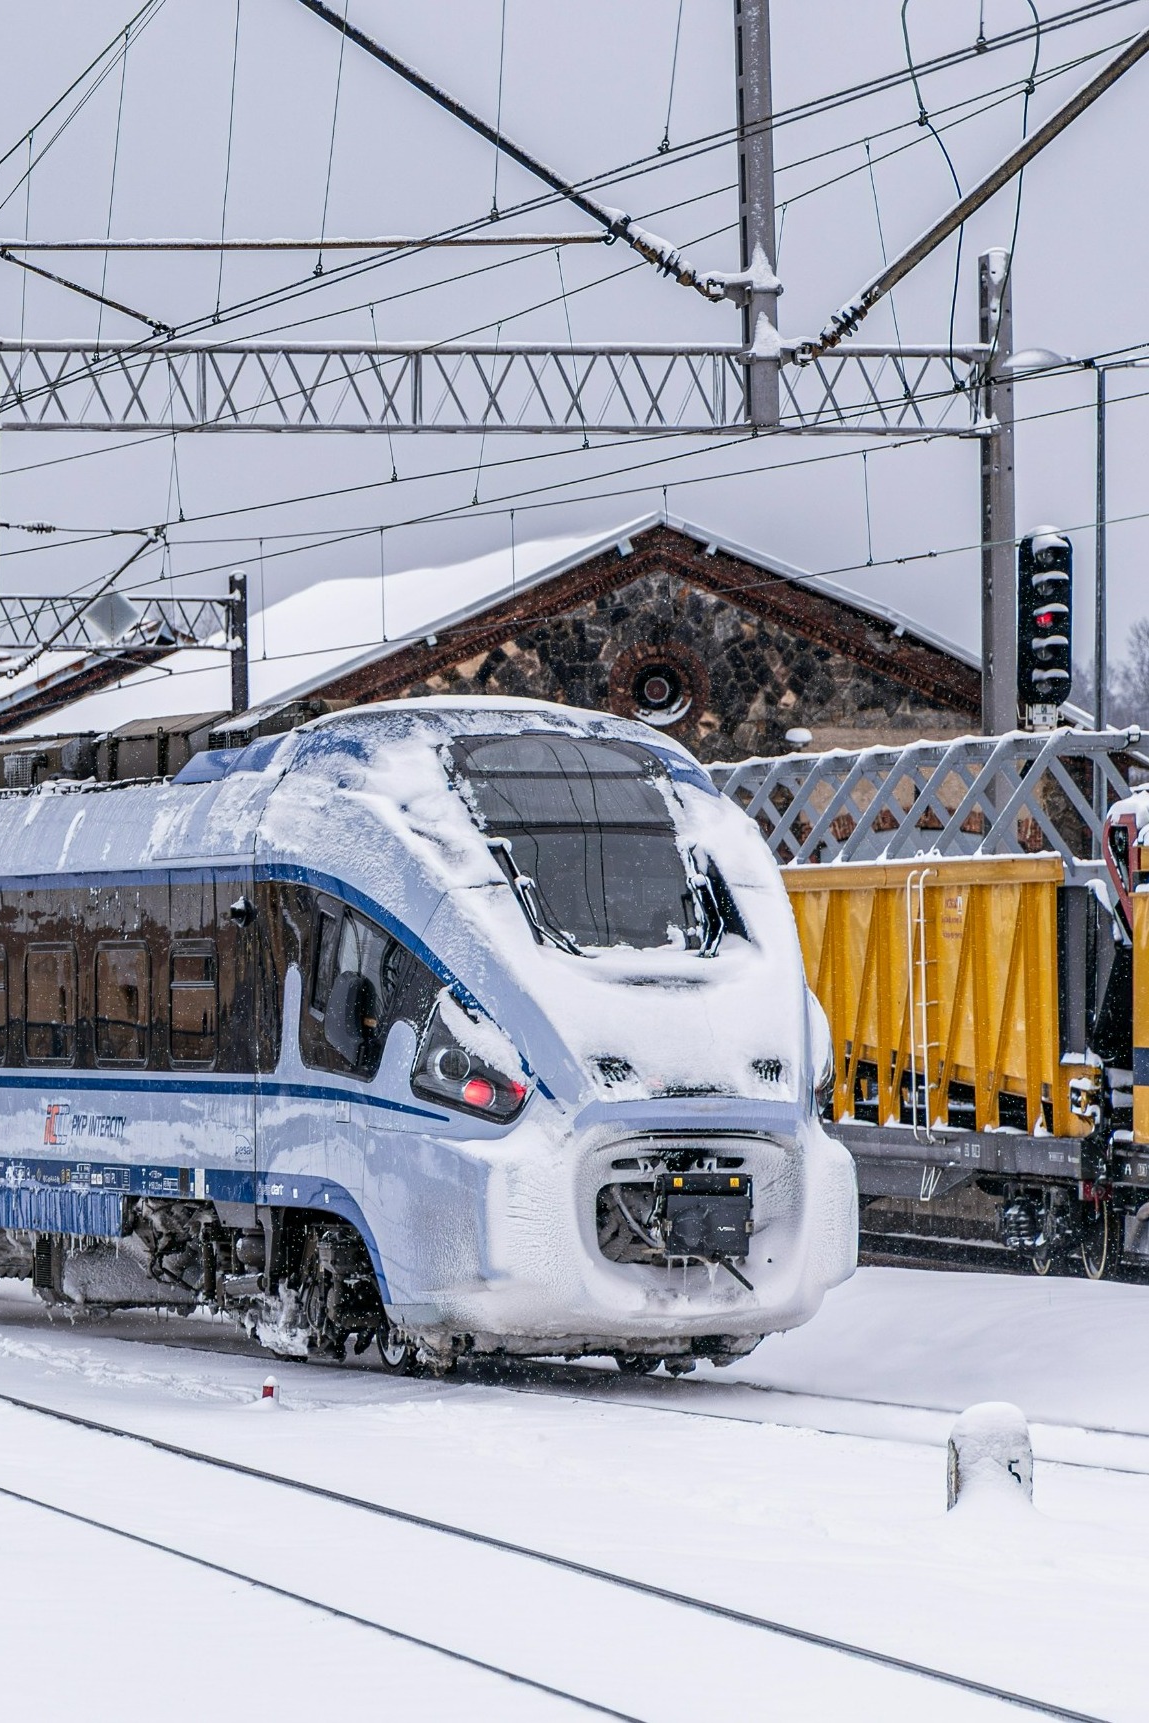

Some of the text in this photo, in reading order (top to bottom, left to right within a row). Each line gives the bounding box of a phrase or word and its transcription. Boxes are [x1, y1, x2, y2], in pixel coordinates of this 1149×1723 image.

[71, 1114, 88, 1137] PKP
[88, 1115, 127, 1138] INTERCITY
[1124, 1163, 1132, 1176] A
